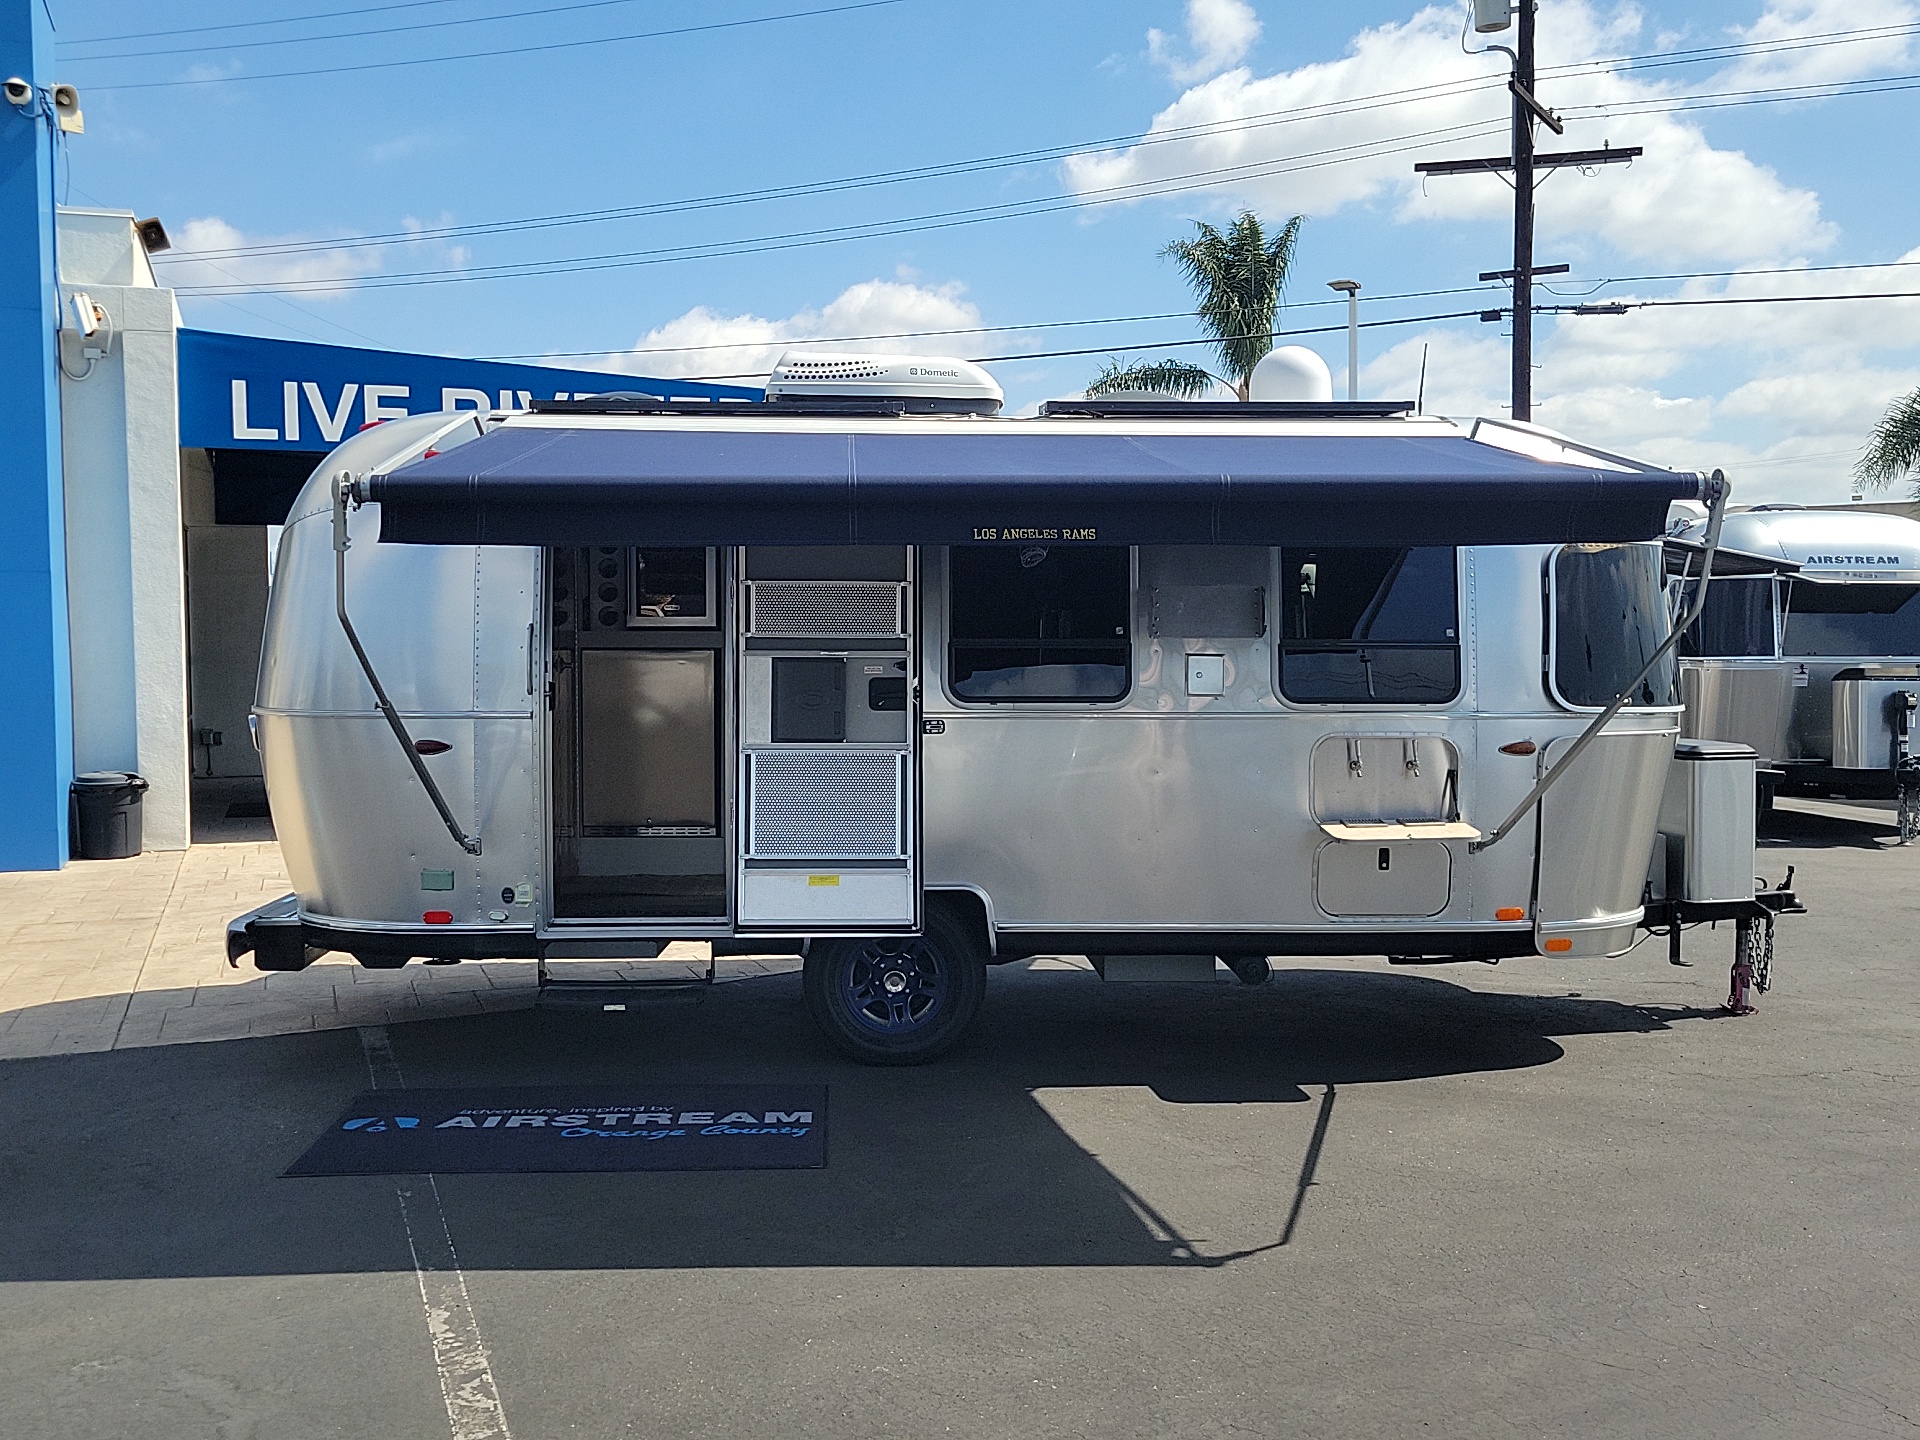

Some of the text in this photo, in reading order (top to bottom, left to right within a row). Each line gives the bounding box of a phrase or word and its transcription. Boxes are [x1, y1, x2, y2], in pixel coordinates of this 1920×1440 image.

[920, 368, 959, 378] Dometic
[231, 379, 410, 443] LIVE
[973, 528, 1097, 540] LOS ANGELES RAMS
[1806, 555, 1900, 565] AIRSTREAM
[569, 1106, 646, 1114] inspired
[434, 1111, 813, 1129] AIRSTREAM
[560, 1124, 811, 1140] Orange County
